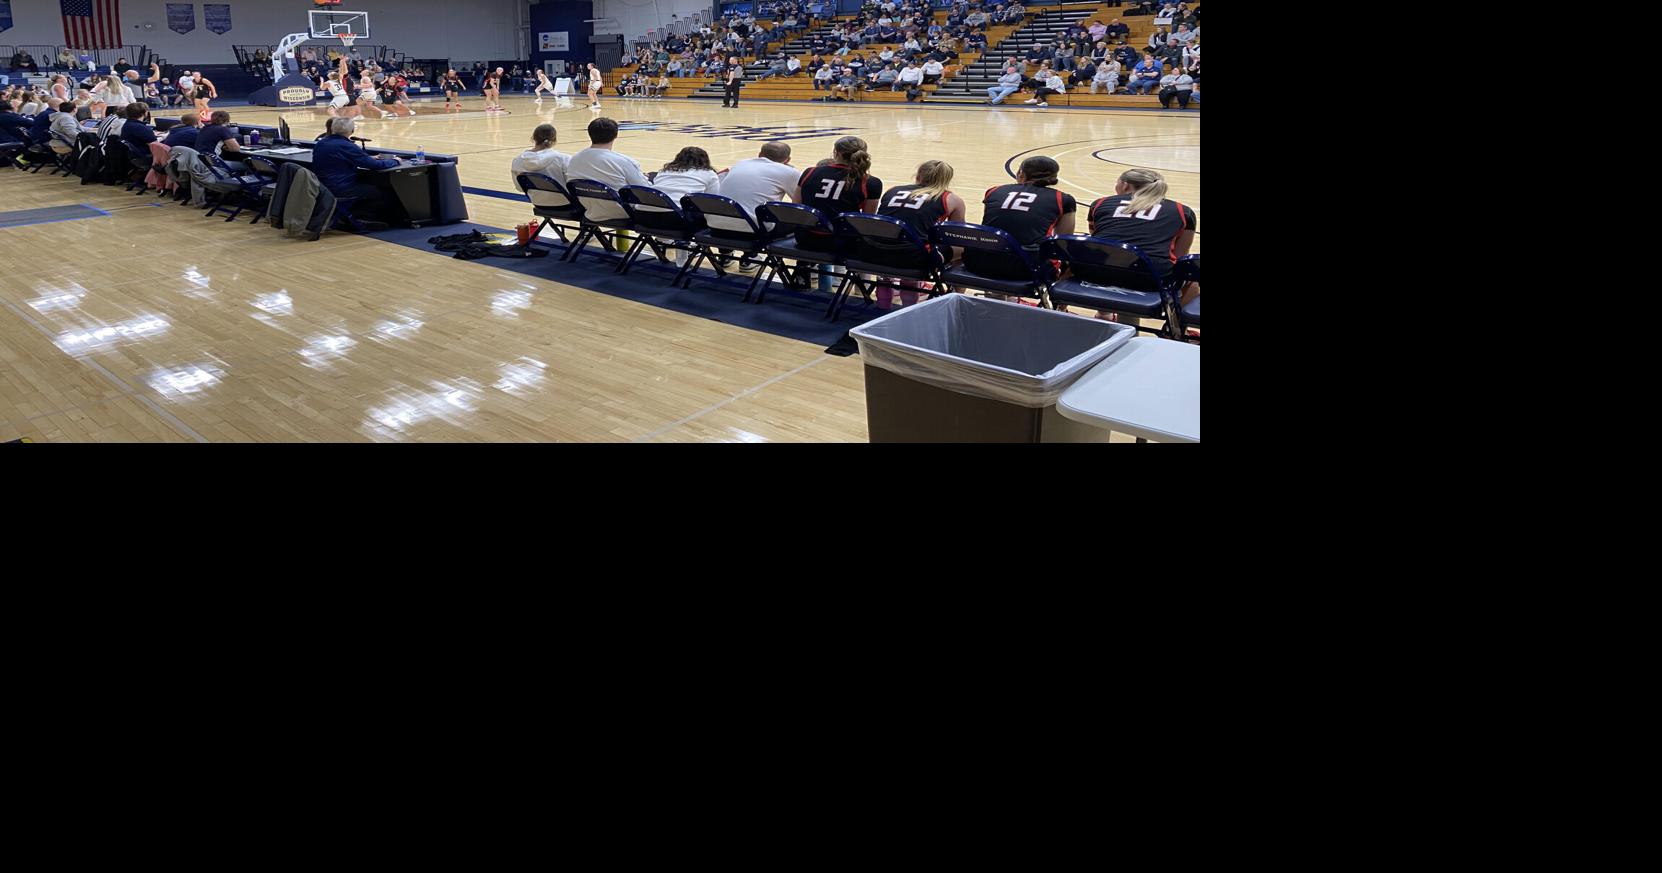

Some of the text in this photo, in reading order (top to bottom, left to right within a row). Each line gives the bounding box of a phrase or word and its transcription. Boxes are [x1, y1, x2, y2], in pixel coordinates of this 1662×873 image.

[815, 178, 845, 200] 31
[888, 190, 930, 210] 23
[1001, 191, 1037, 212] 12
